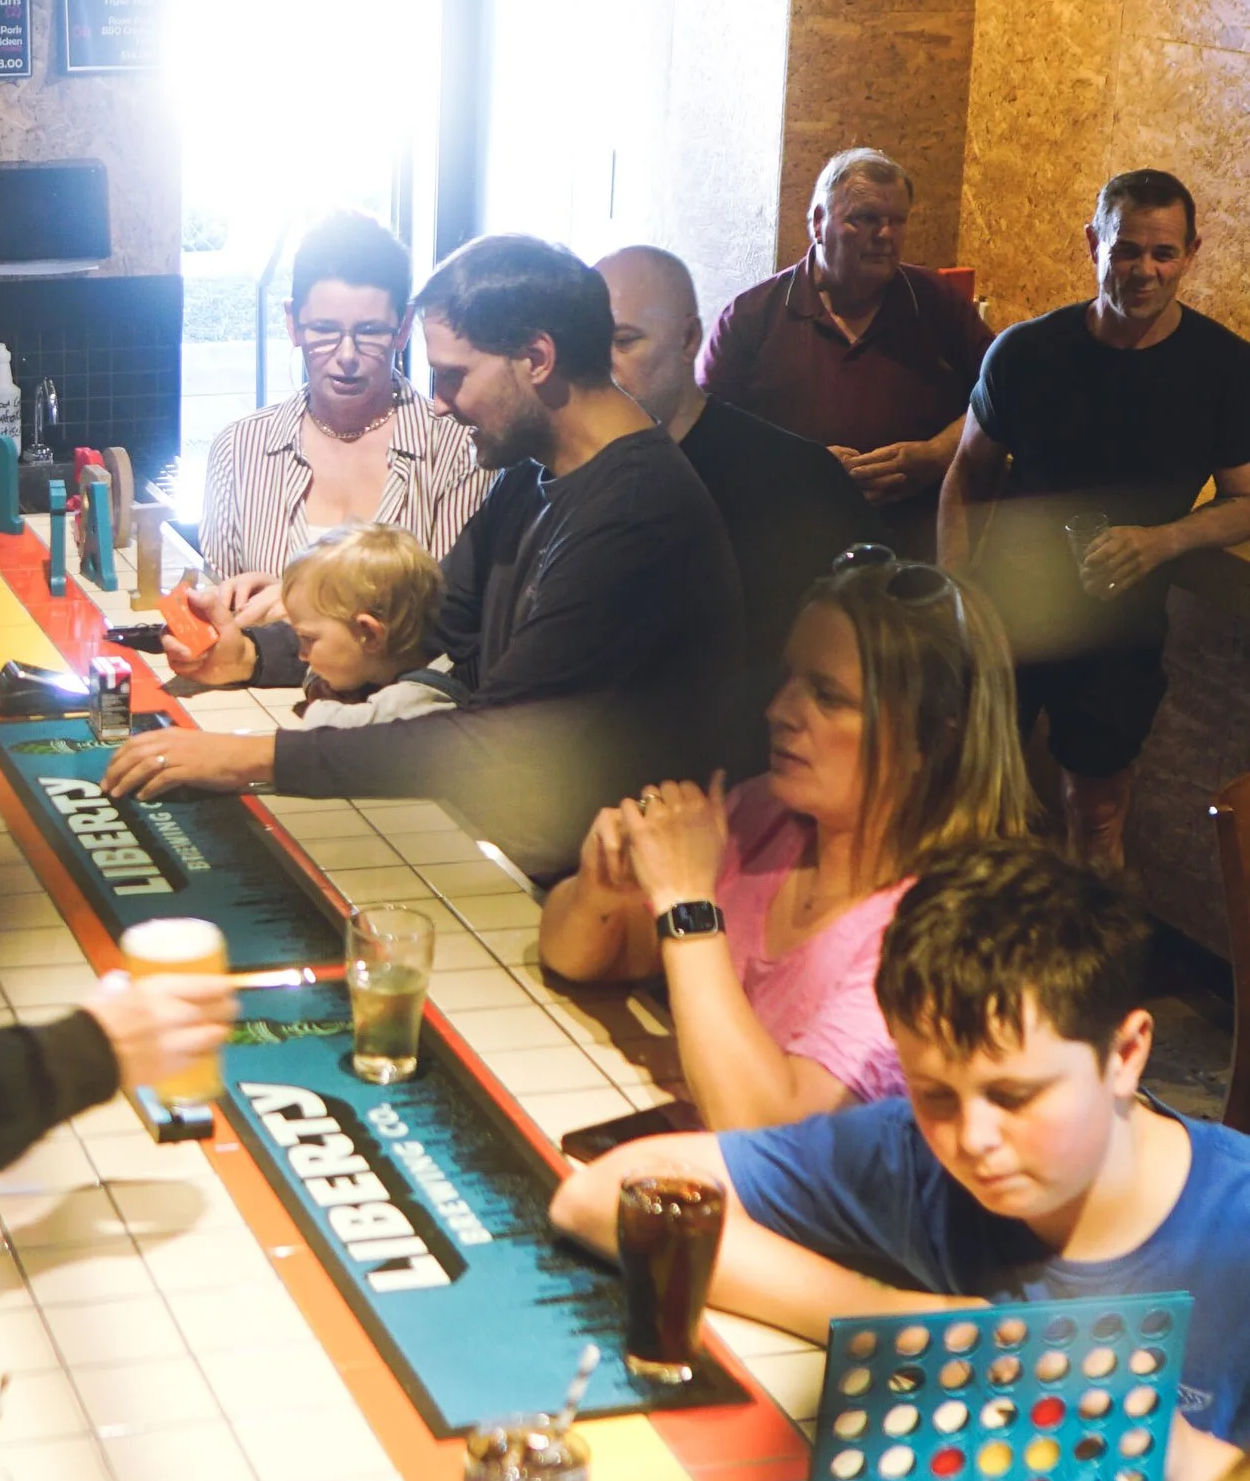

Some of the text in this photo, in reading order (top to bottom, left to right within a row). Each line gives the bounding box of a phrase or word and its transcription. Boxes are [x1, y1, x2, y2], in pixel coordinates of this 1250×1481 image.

[0, 24, 22, 35] Pork
[37, 776, 174, 896] LIBERTY
[149, 810, 211, 870] BREWING
[237, 1081, 452, 1293] LIBERTY
[392, 1140, 493, 1246] BREWING
